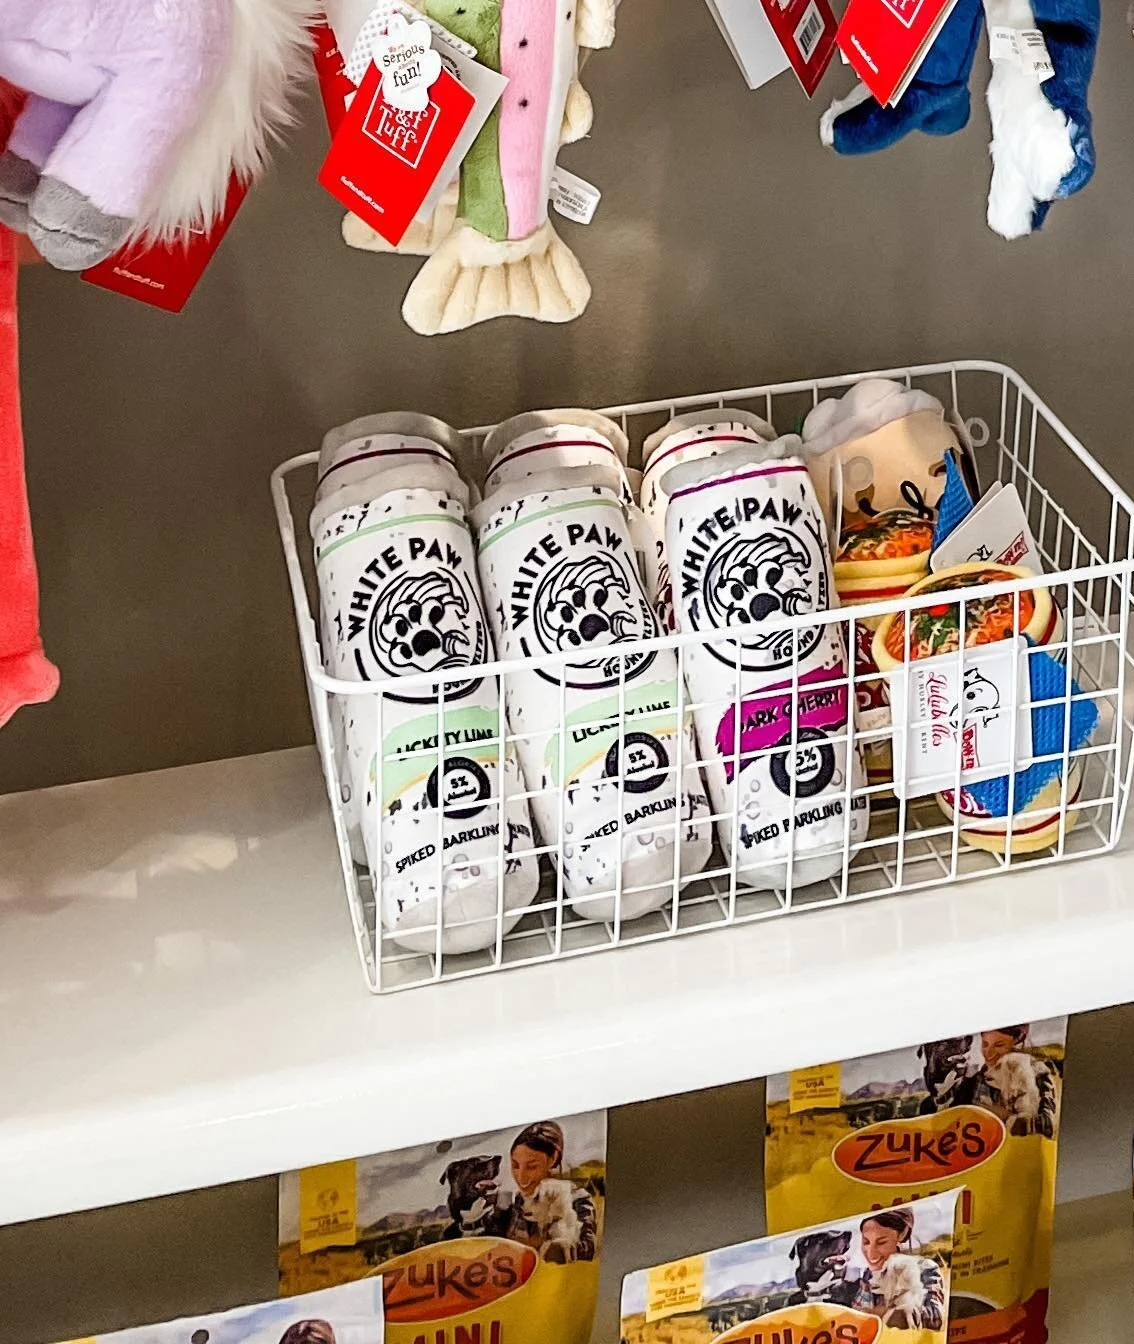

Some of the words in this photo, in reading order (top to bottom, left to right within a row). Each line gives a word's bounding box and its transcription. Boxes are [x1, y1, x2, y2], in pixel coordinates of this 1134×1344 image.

[382, 43, 425, 68] Serious
[392, 61, 422, 88] fun!
[375, 105, 418, 152] Tuff
[681, 506, 736, 599] WHITE
[742, 497, 803, 526] PAW
[348, 545, 404, 641] WHITE
[409, 537, 463, 570] PAW
[511, 533, 563, 630] WHITE
[566, 522, 623, 551] PAW
[628, 749, 647, 763] 5%
[450, 776, 469, 789] 5%
[395, 843, 437, 874] SPIKED
